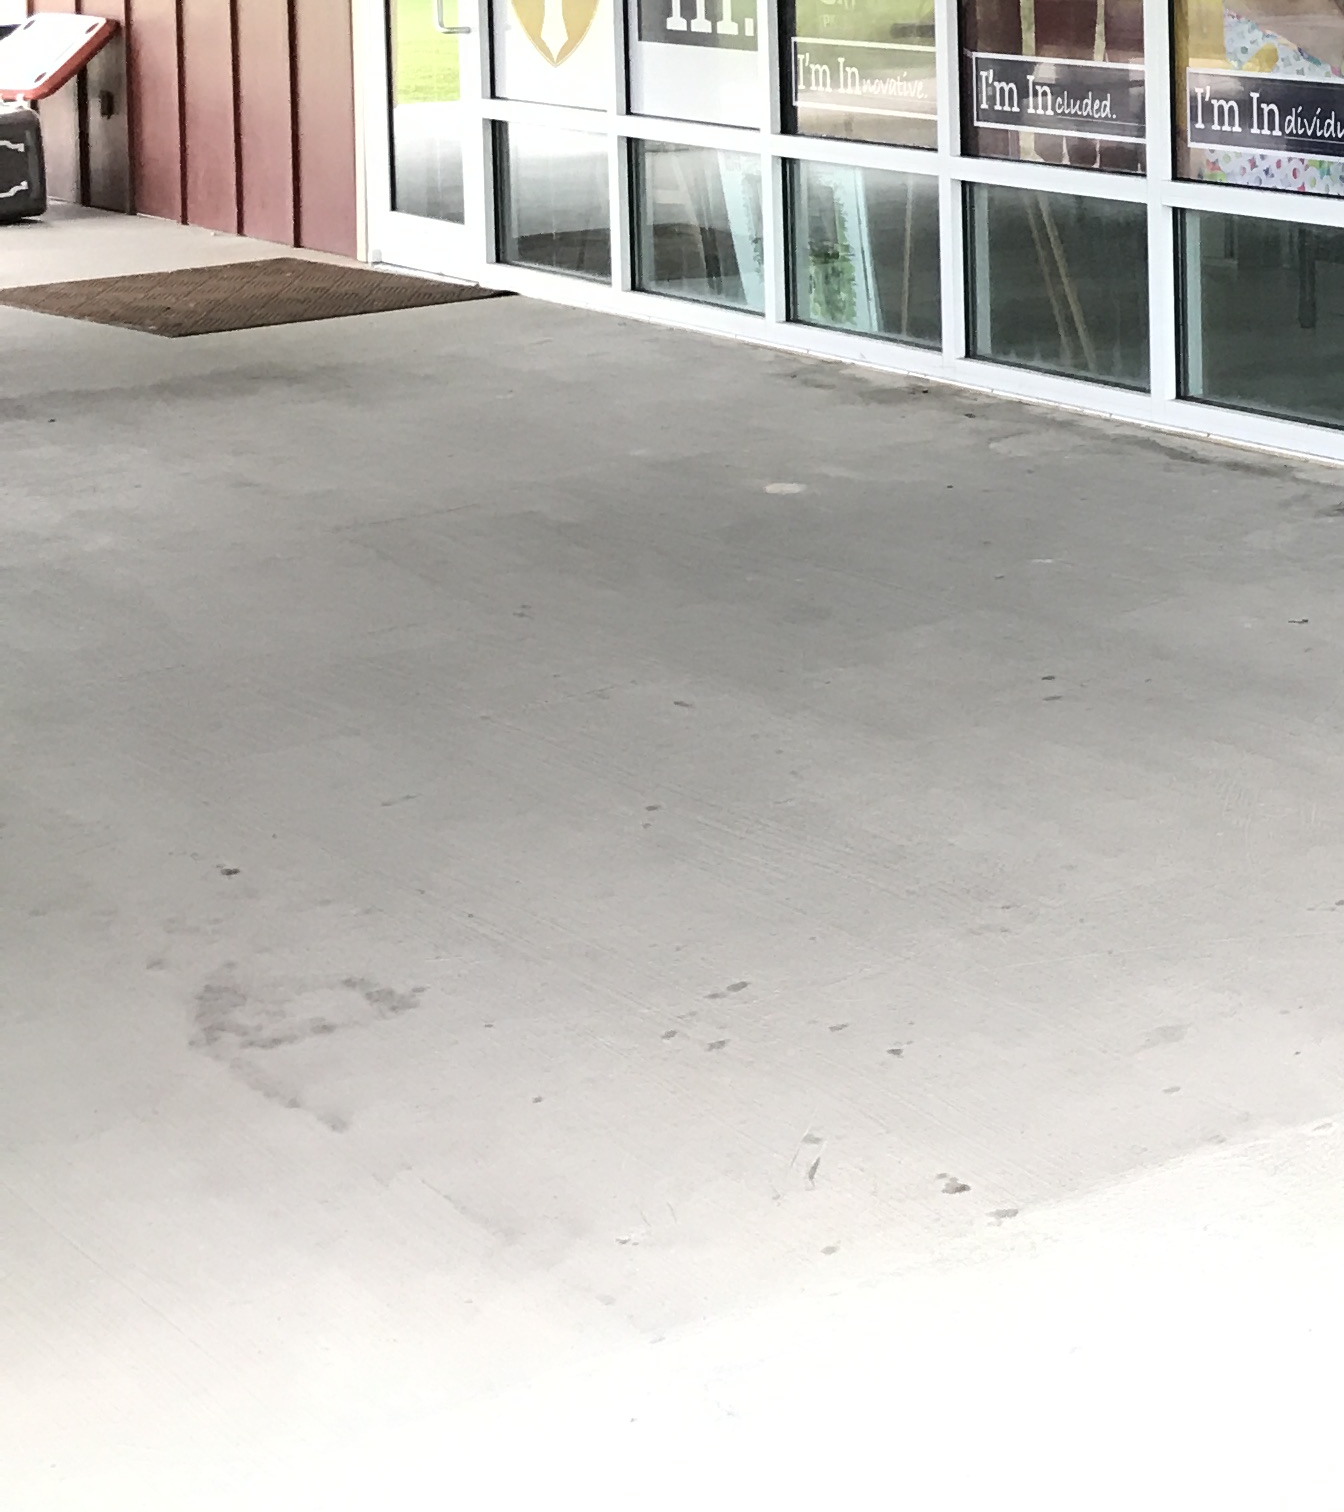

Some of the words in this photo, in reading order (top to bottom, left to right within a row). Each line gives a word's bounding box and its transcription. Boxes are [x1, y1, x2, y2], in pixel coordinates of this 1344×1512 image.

[797, 52, 833, 93] I'm
[979, 69, 1021, 112] I'm
[1194, 85, 1243, 132] I'm
